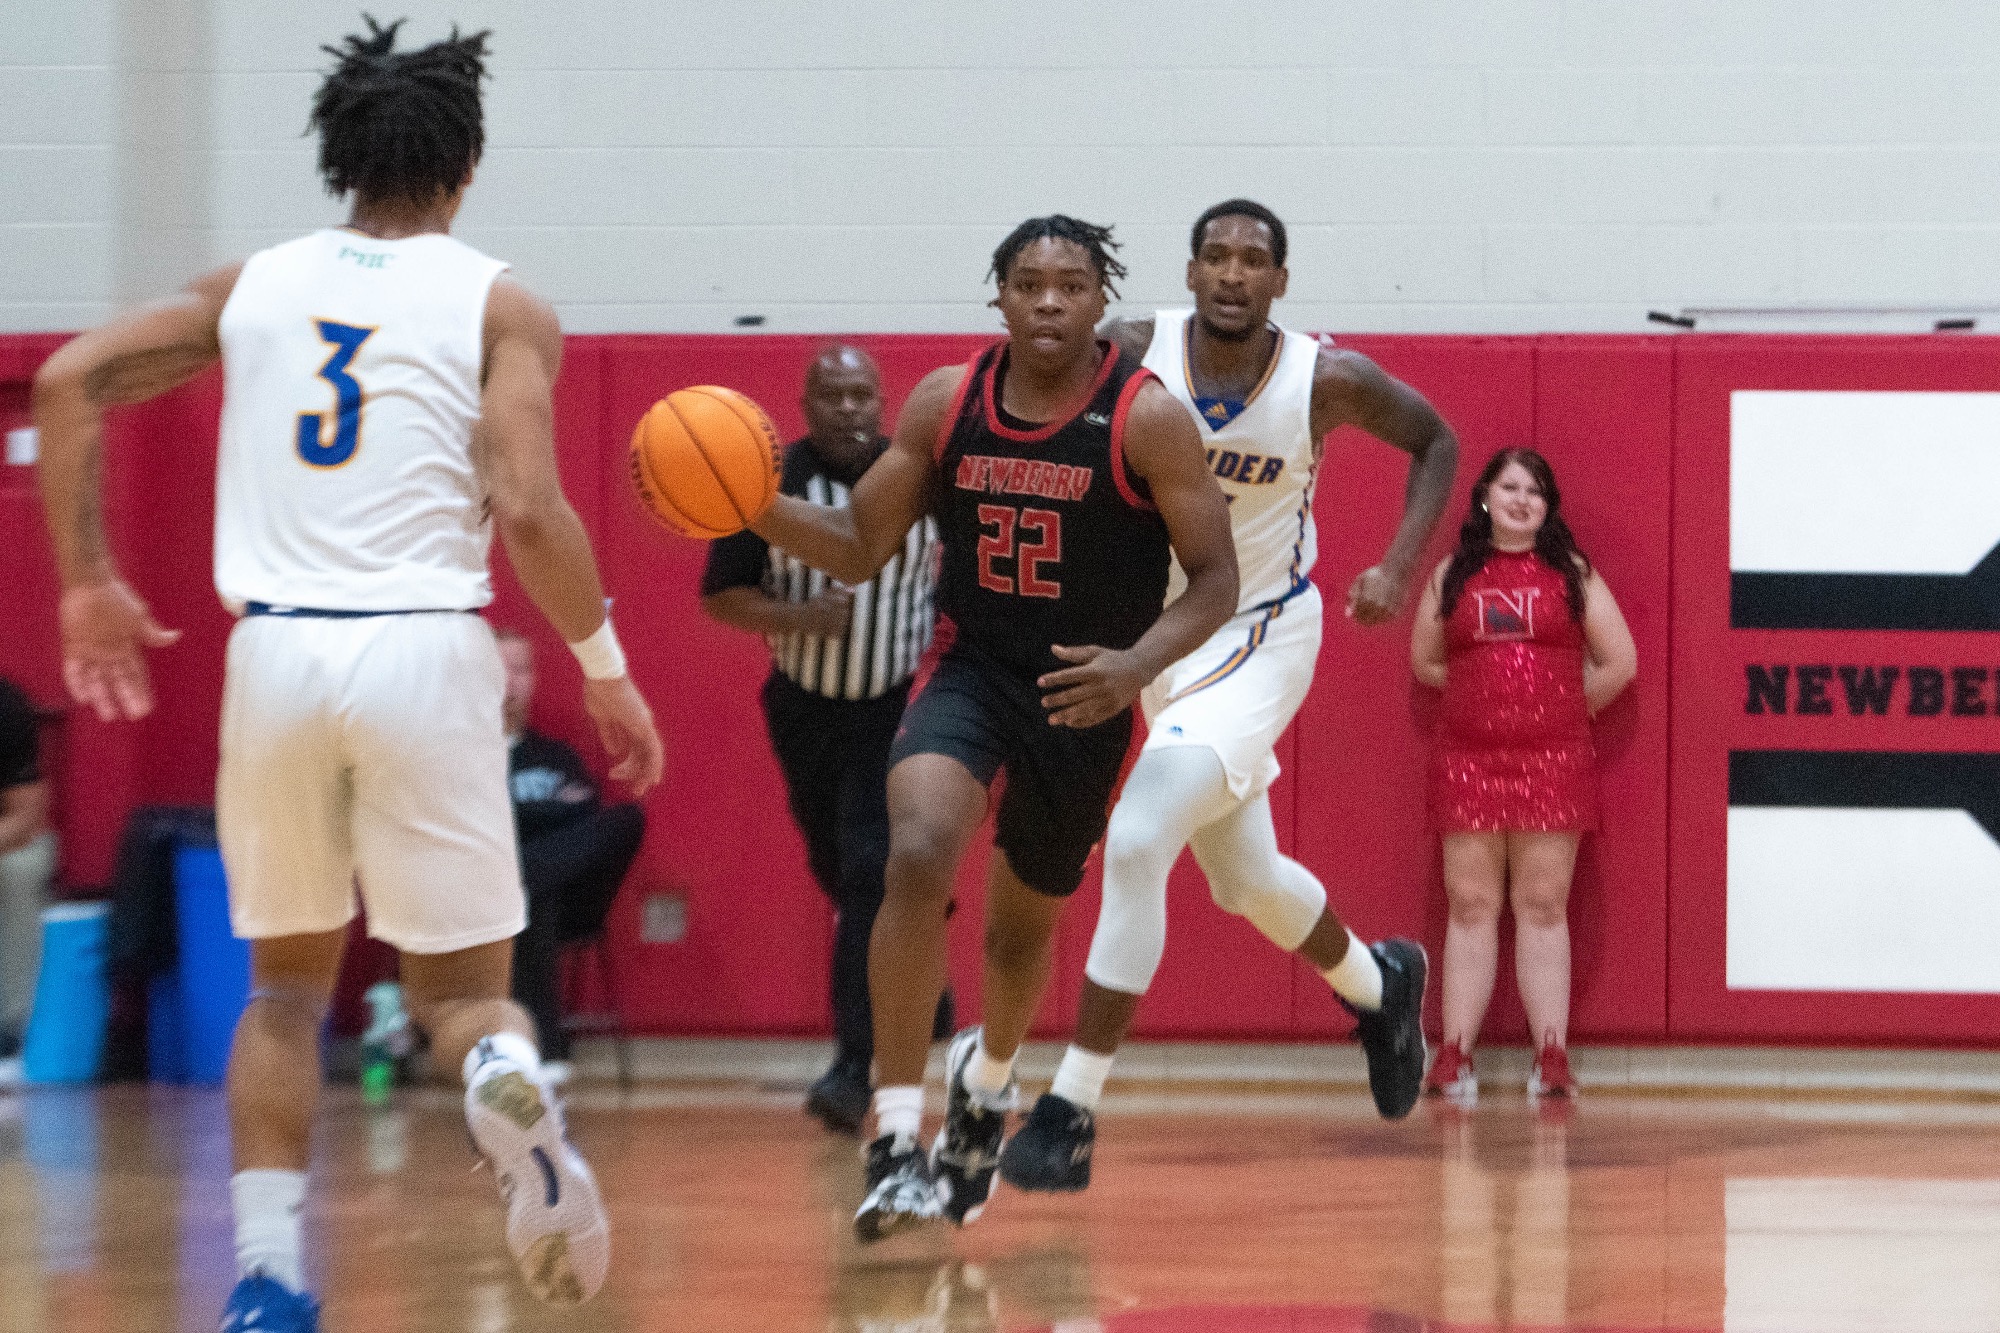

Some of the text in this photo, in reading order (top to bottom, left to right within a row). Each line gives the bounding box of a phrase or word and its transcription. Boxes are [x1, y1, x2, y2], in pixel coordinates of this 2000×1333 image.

[294, 316, 381, 471] 3
[955, 454, 1093, 502] NEWBERRY
[976, 503, 1062, 599] 22
[1472, 586, 1541, 641] N
[1744, 663, 2000, 717] NEWBE
